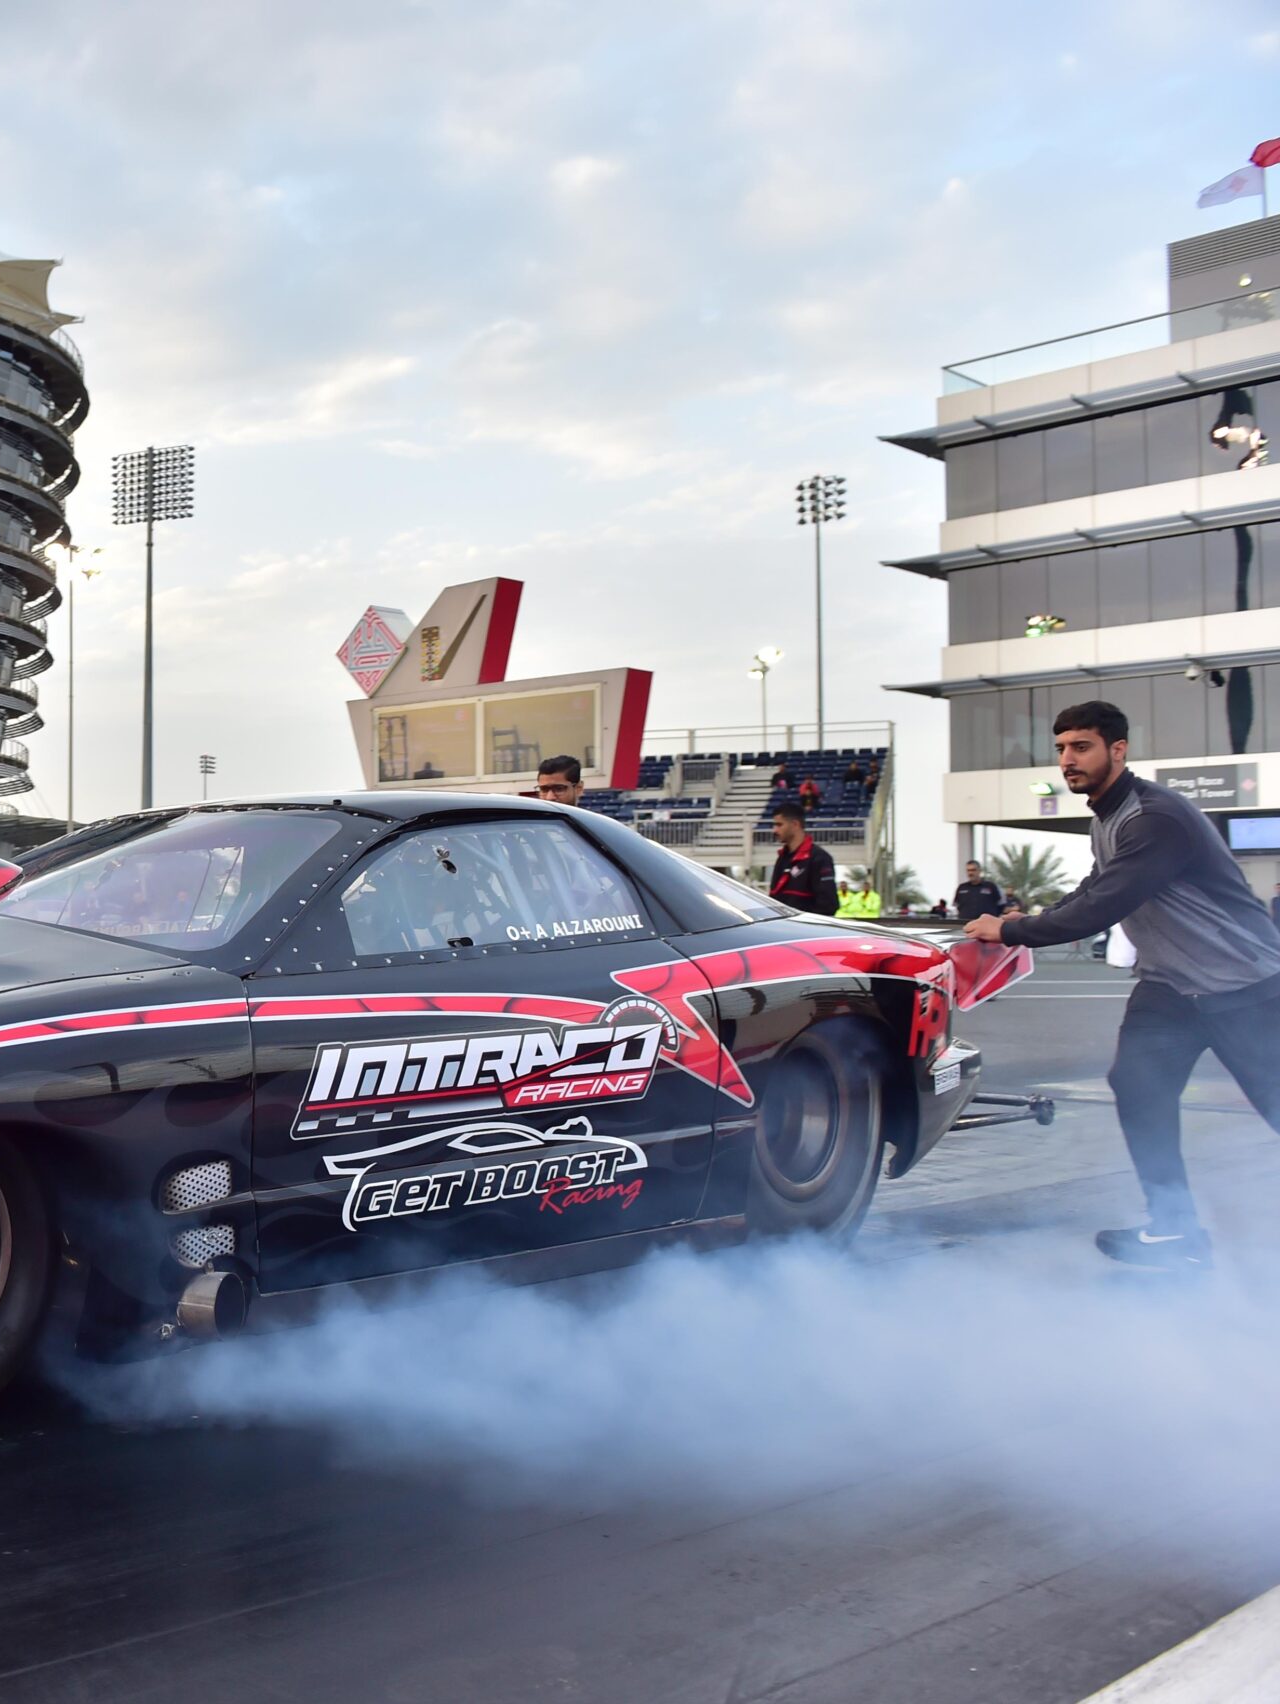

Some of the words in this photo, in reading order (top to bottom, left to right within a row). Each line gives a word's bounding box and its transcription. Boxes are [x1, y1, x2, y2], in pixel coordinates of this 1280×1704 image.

[1167, 778, 1195, 789] Drag
[1197, 777, 1224, 786] Race
[1200, 788, 1236, 798] Tower
[514, 1074, 647, 1104] RACING
[464, 1147, 627, 1206] BOOST
[538, 1177, 644, 1214] Racing
